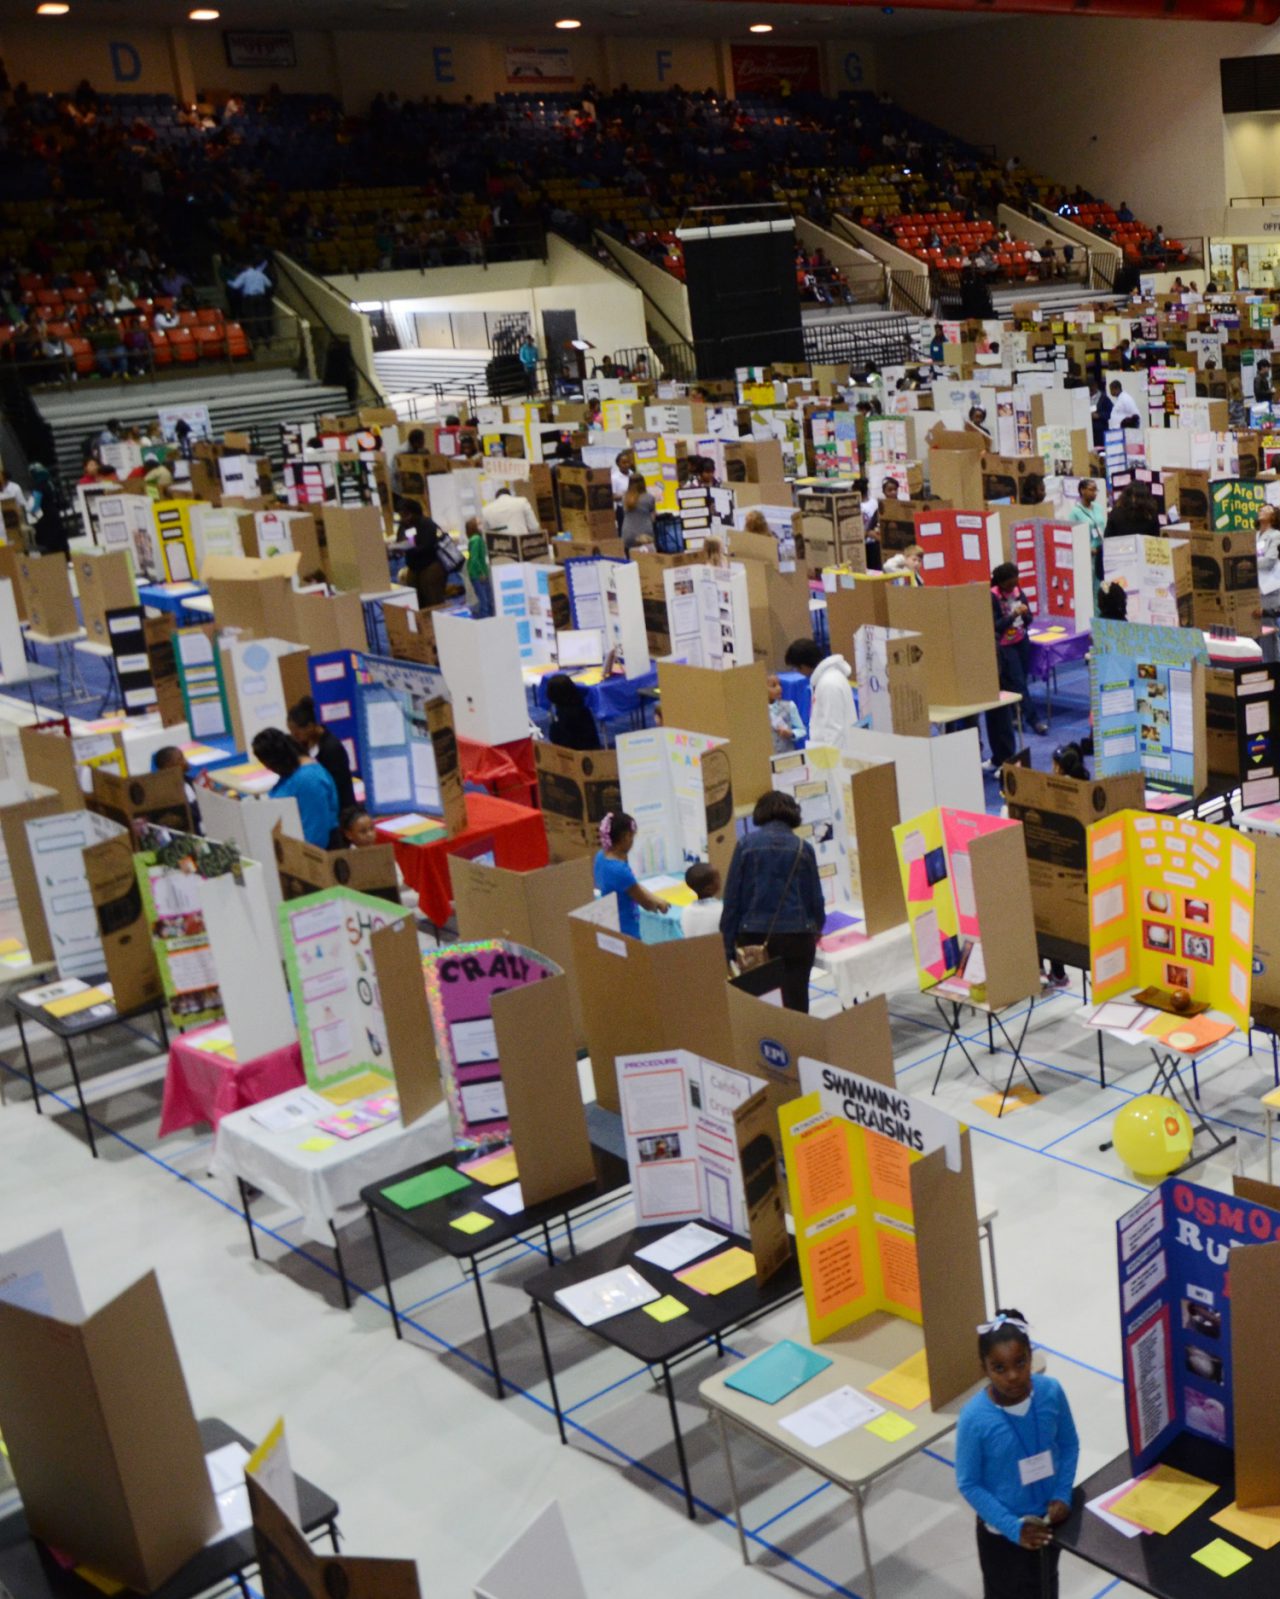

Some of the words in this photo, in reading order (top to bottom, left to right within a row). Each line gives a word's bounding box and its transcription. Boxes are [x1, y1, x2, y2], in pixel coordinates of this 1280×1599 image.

[109, 42, 141, 82] D
[433, 48, 454, 82] E
[657, 51, 672, 81] F
[844, 53, 863, 82] G
[1233, 482, 1252, 499] Are
[624, 1057, 677, 1069] PROCEDURE
[764, 1045, 786, 1064] EPI
[822, 1069, 910, 1121] SWIMMING
[843, 1100, 924, 1151] CRAISINS
